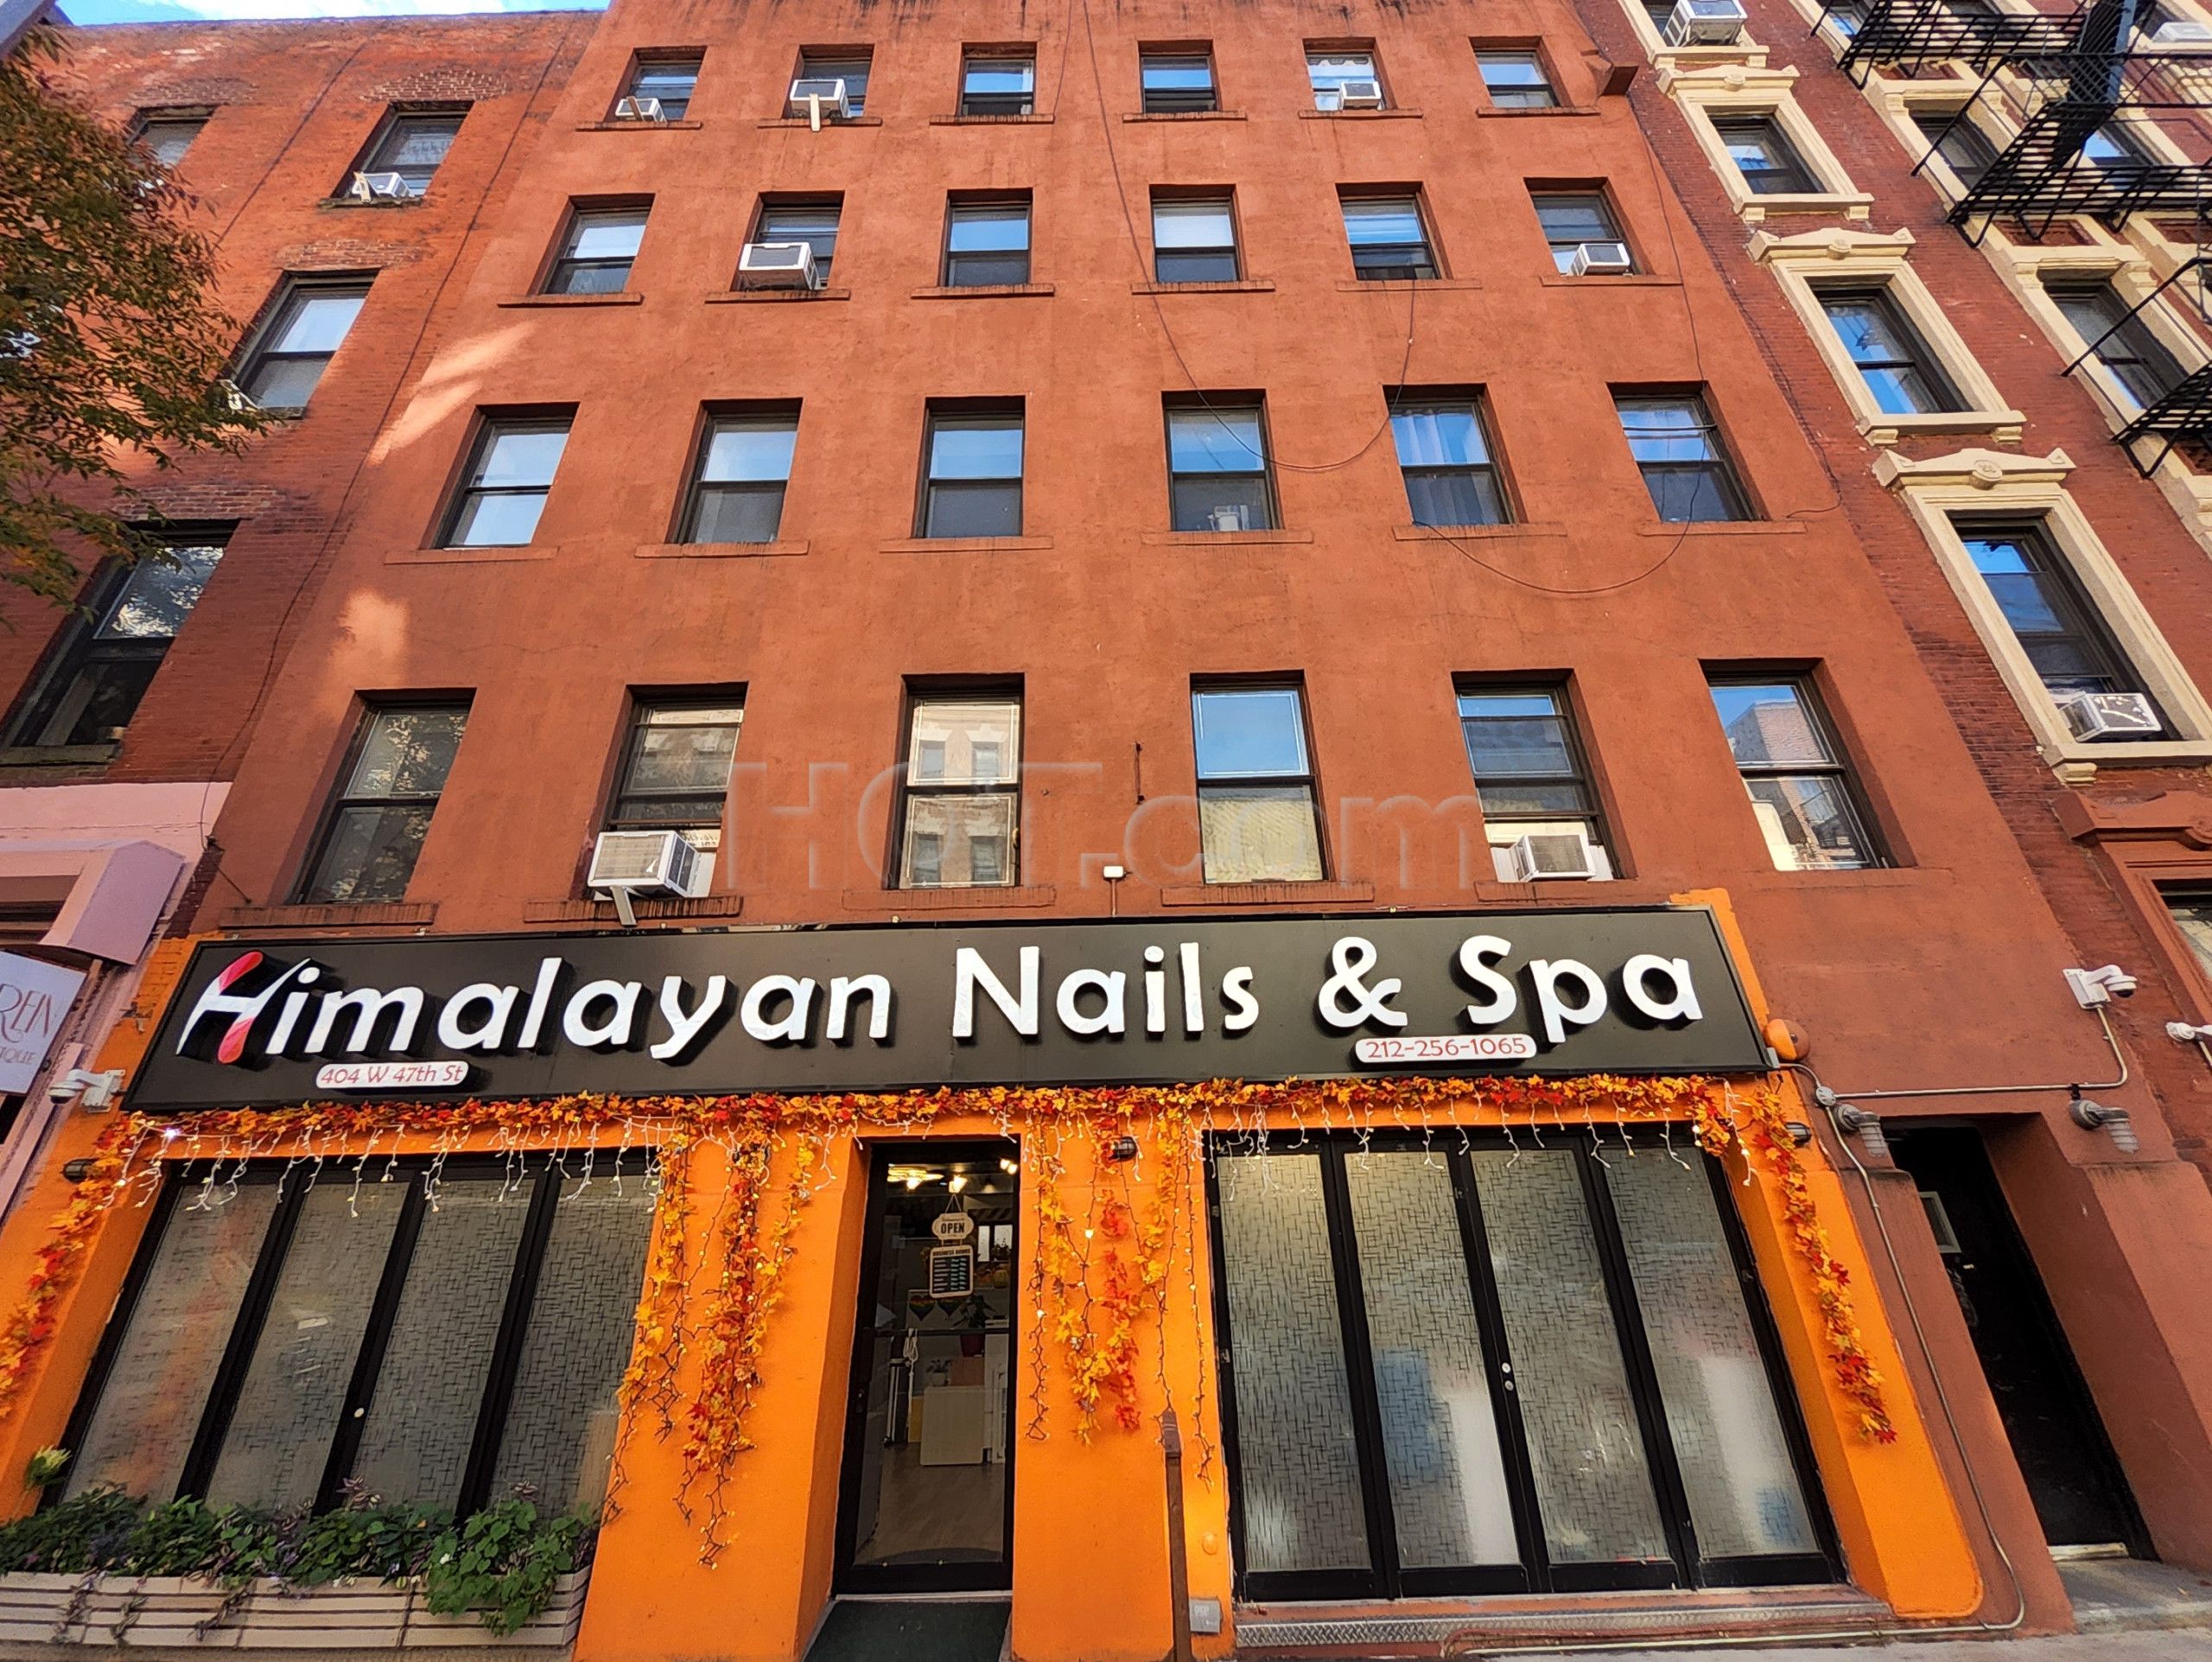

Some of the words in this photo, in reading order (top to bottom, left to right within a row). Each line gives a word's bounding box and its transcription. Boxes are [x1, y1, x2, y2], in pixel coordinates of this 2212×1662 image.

[175, 951, 891, 1064] Himalayan
[951, 942, 1259, 1037] Nails
[1318, 936, 1408, 1028] &
[1458, 934, 1704, 1042] Spa
[1365, 1037, 1527, 1059] 212-256-1065
[321, 1068, 360, 1084] 404
[367, 1065, 390, 1083] W
[392, 1064, 436, 1083] 47th
[442, 1064, 464, 1082] St
[940, 1222, 965, 1234] OPEN
